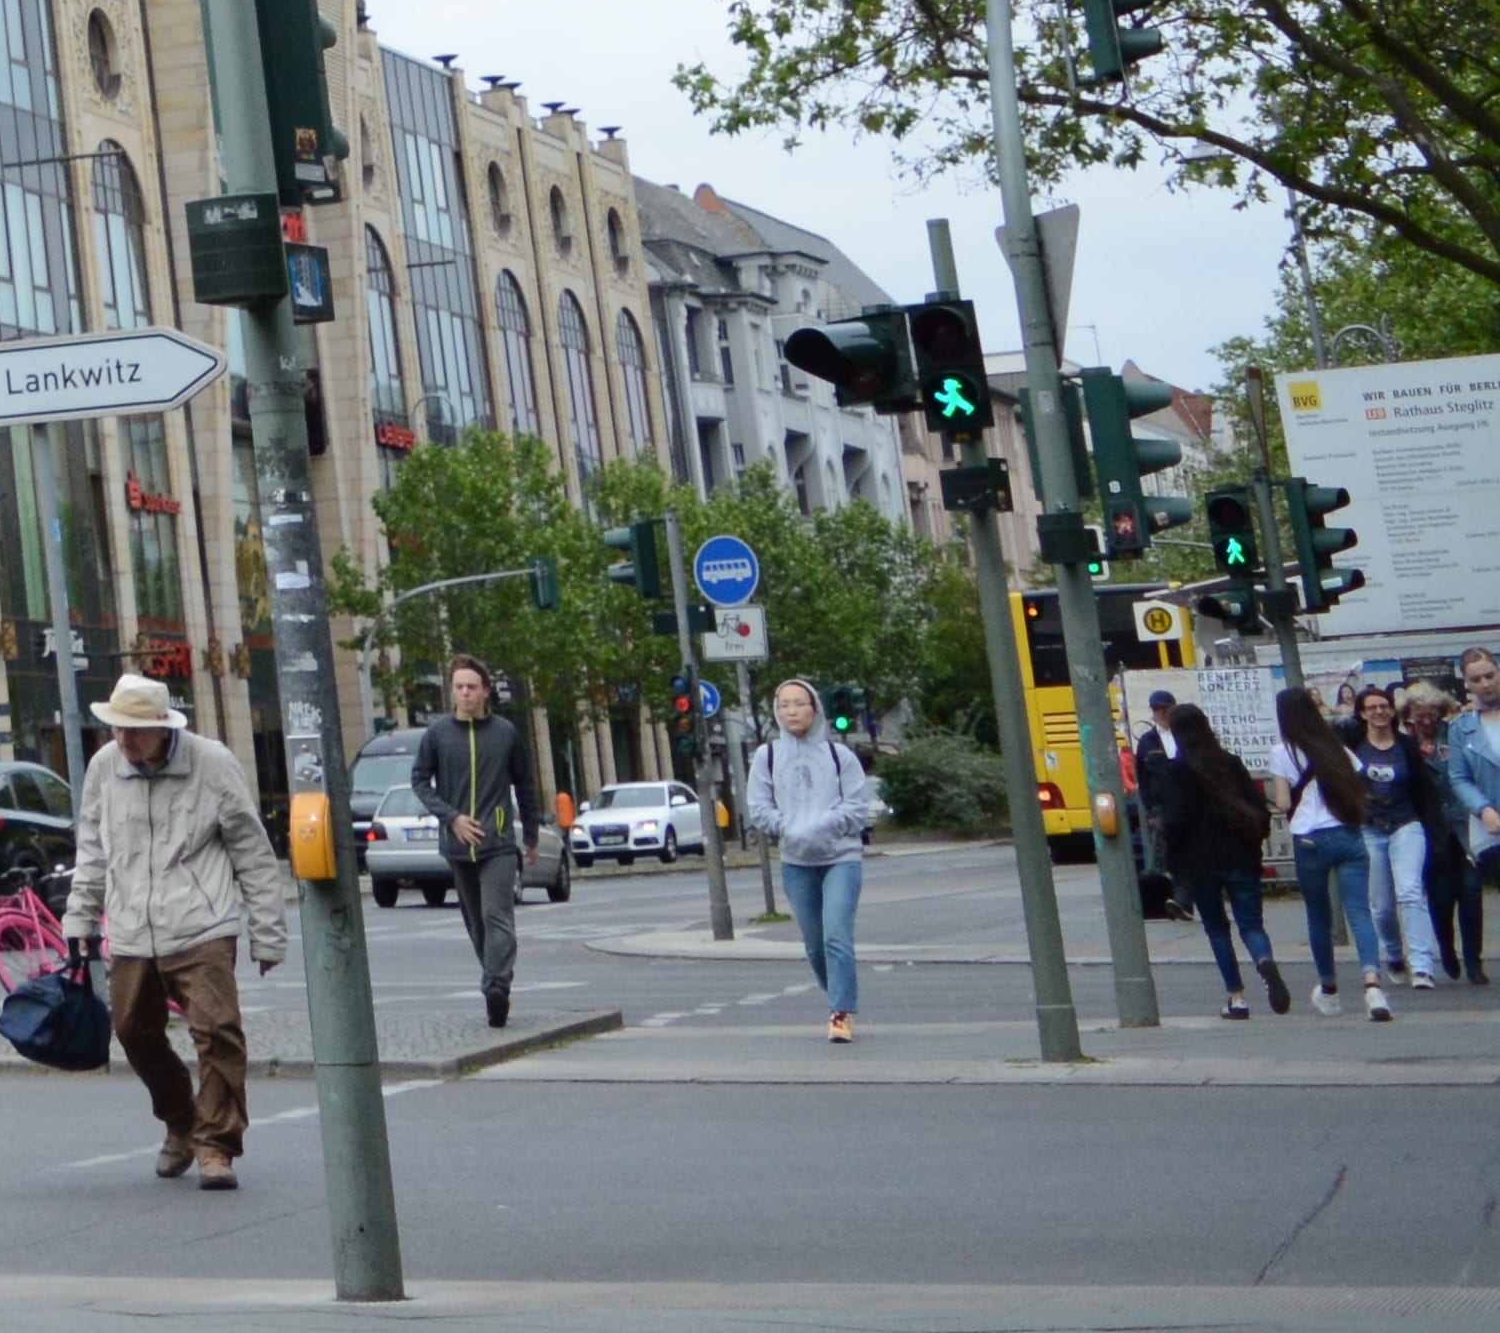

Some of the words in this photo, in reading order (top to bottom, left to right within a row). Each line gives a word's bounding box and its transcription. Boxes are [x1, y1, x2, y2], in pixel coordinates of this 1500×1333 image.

[6, 359, 142, 395] Lankwitz
[1362, 391, 1385, 401] WIR
[1393, 387, 1432, 399] BAUEN
[1440, 383, 1461, 395] FÜR
[1470, 380, 1500, 392] BERLI
[1293, 395, 1318, 408] BVG
[1394, 405, 1444, 418] Rathaus
[1447, 399, 1494, 415] Steglitz
[1198, 670, 1260, 682] BENEFIZ
[1199, 682, 1261, 693] KONZERT
[1222, 735, 1277, 746] RASATE
